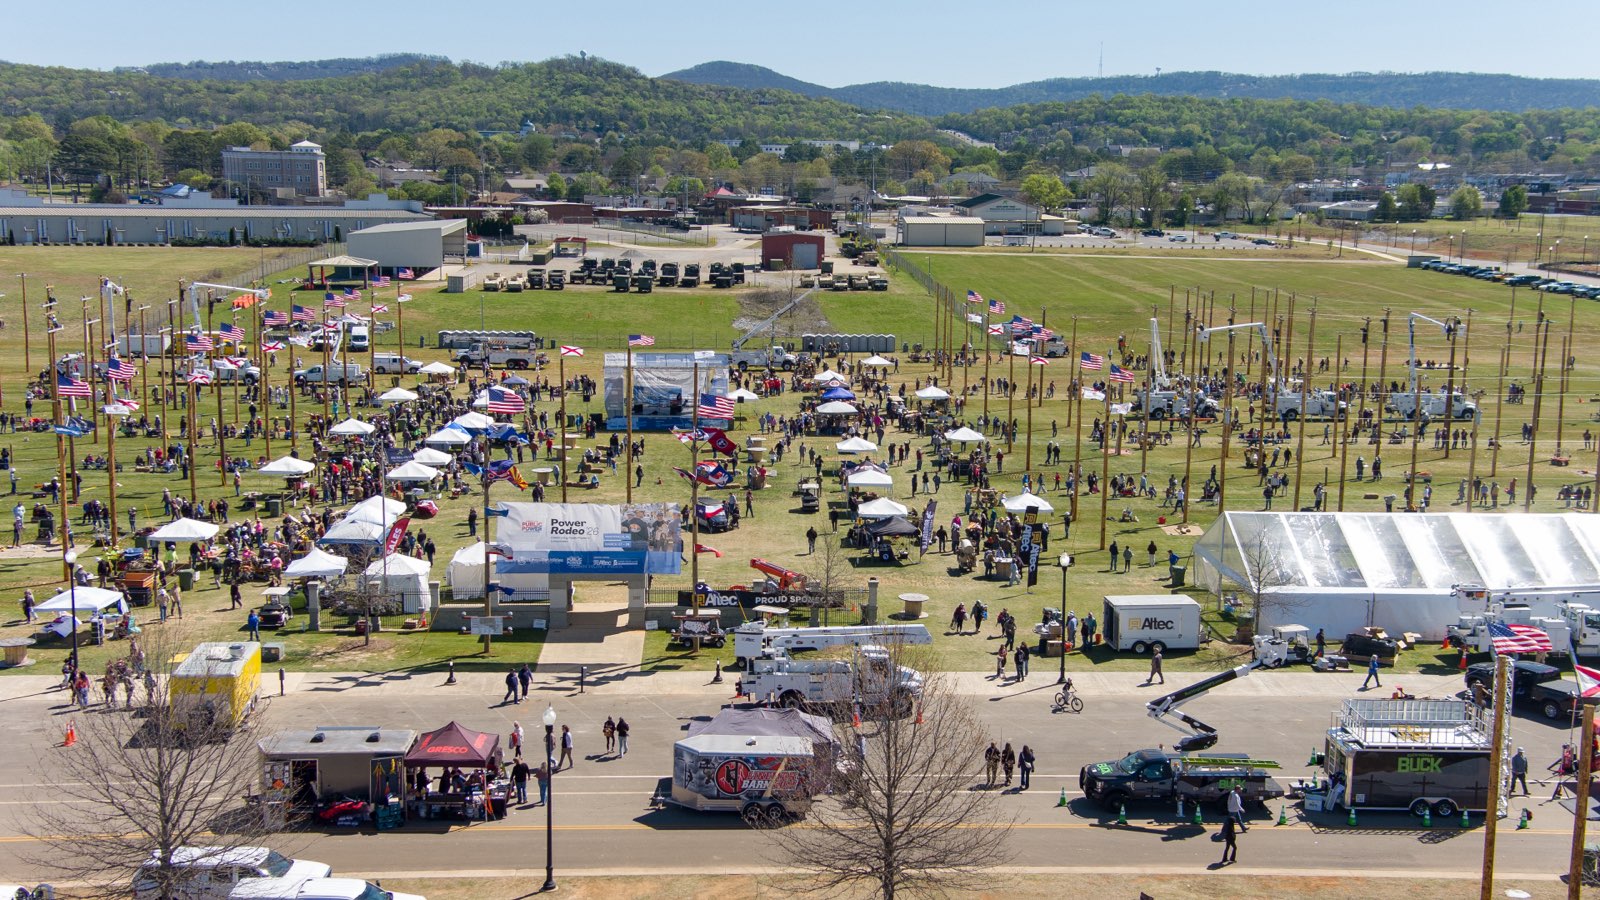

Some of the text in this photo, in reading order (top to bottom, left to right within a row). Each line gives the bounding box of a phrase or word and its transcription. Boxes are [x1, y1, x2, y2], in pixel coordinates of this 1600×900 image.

[551, 518, 587, 527] Power
[550, 526, 585, 535] Rodeo
[386, 527, 403, 556] SALES
[1020, 524, 1034, 552] Altec
[1029, 544, 1041, 573] Altec
[705, 593, 739, 607] Altec
[755, 596, 788, 605] PROUD
[1141, 617, 1175, 630] Altec
[427, 745, 469, 754] GRESCO
[1397, 756, 1444, 773] BUCK
